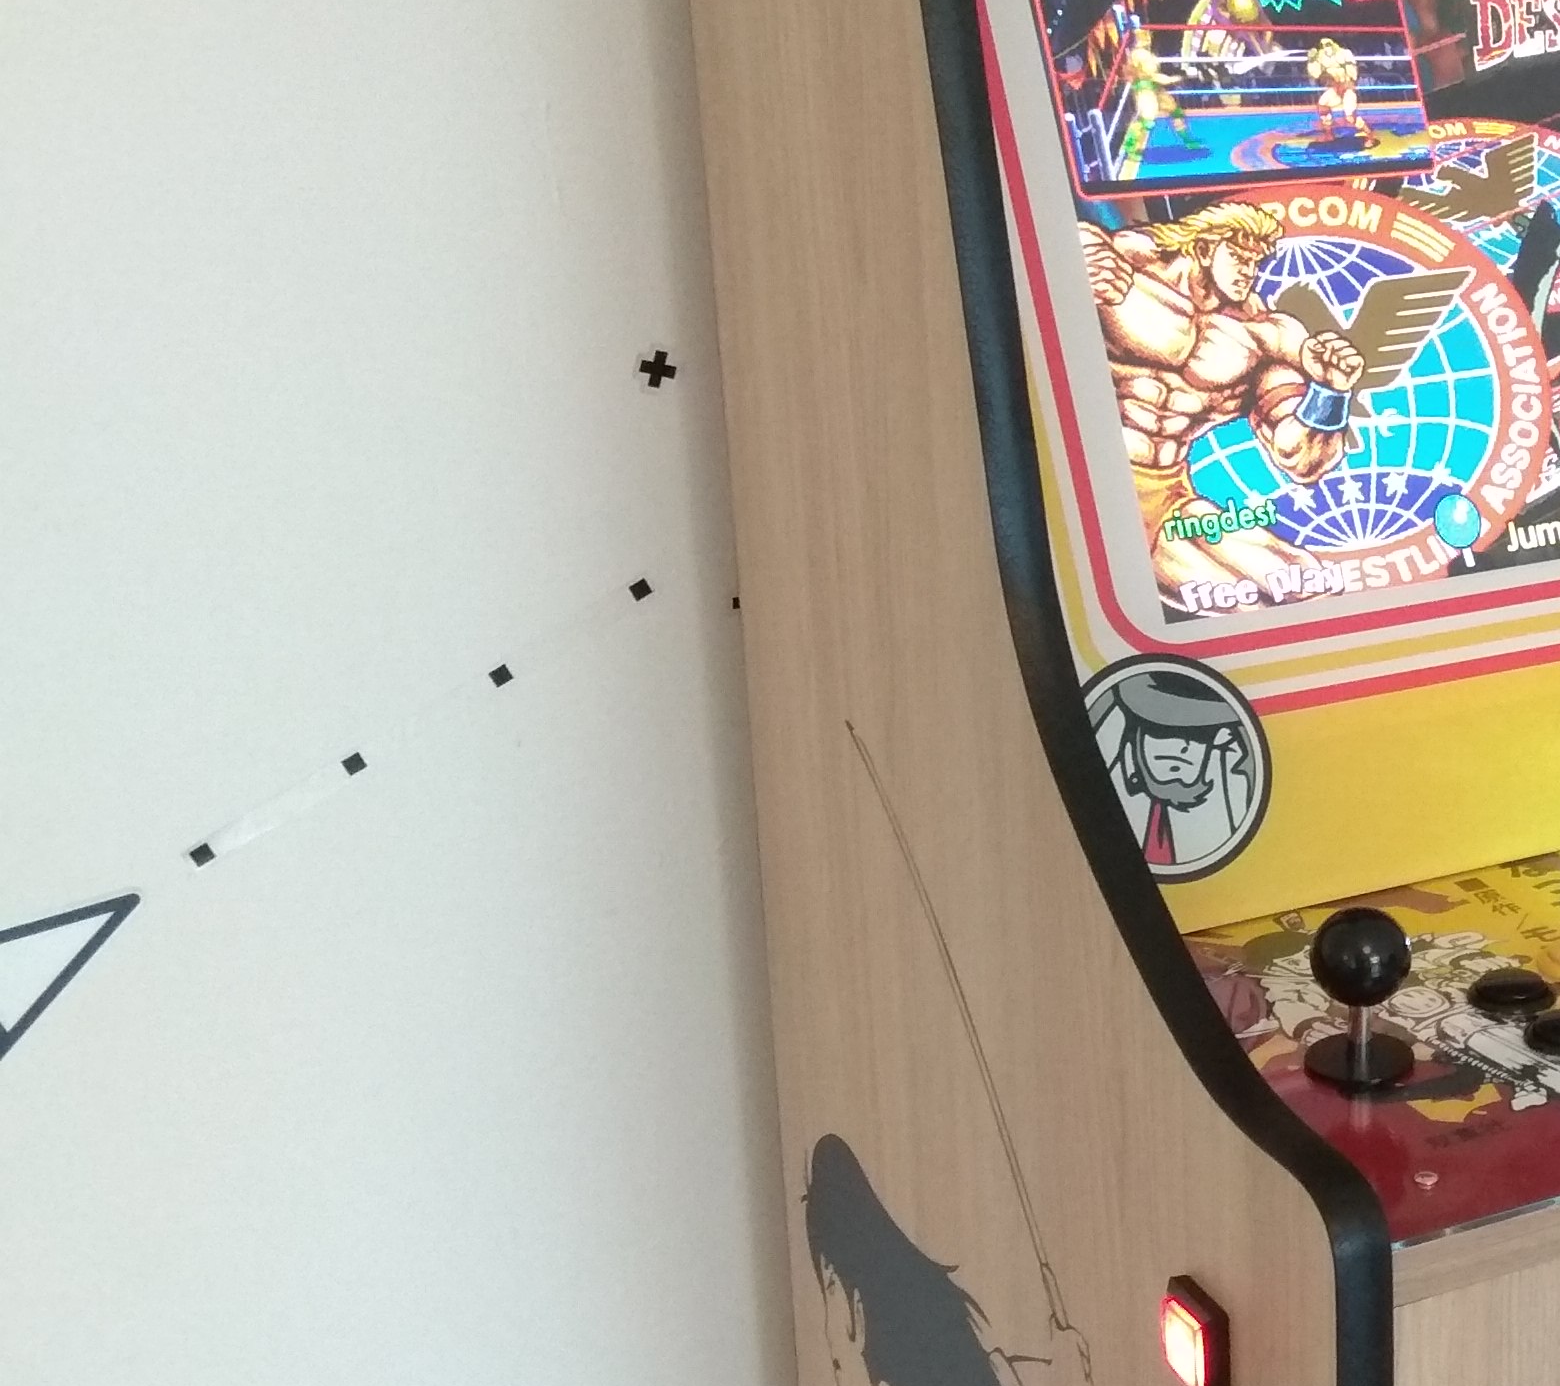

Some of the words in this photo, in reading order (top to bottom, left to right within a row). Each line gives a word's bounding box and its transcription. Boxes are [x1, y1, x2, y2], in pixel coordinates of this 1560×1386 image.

[1471, 281, 1543, 516] ASSOCIATION
[1163, 497, 1277, 544] ringdest
[1180, 579, 1259, 613] Free
